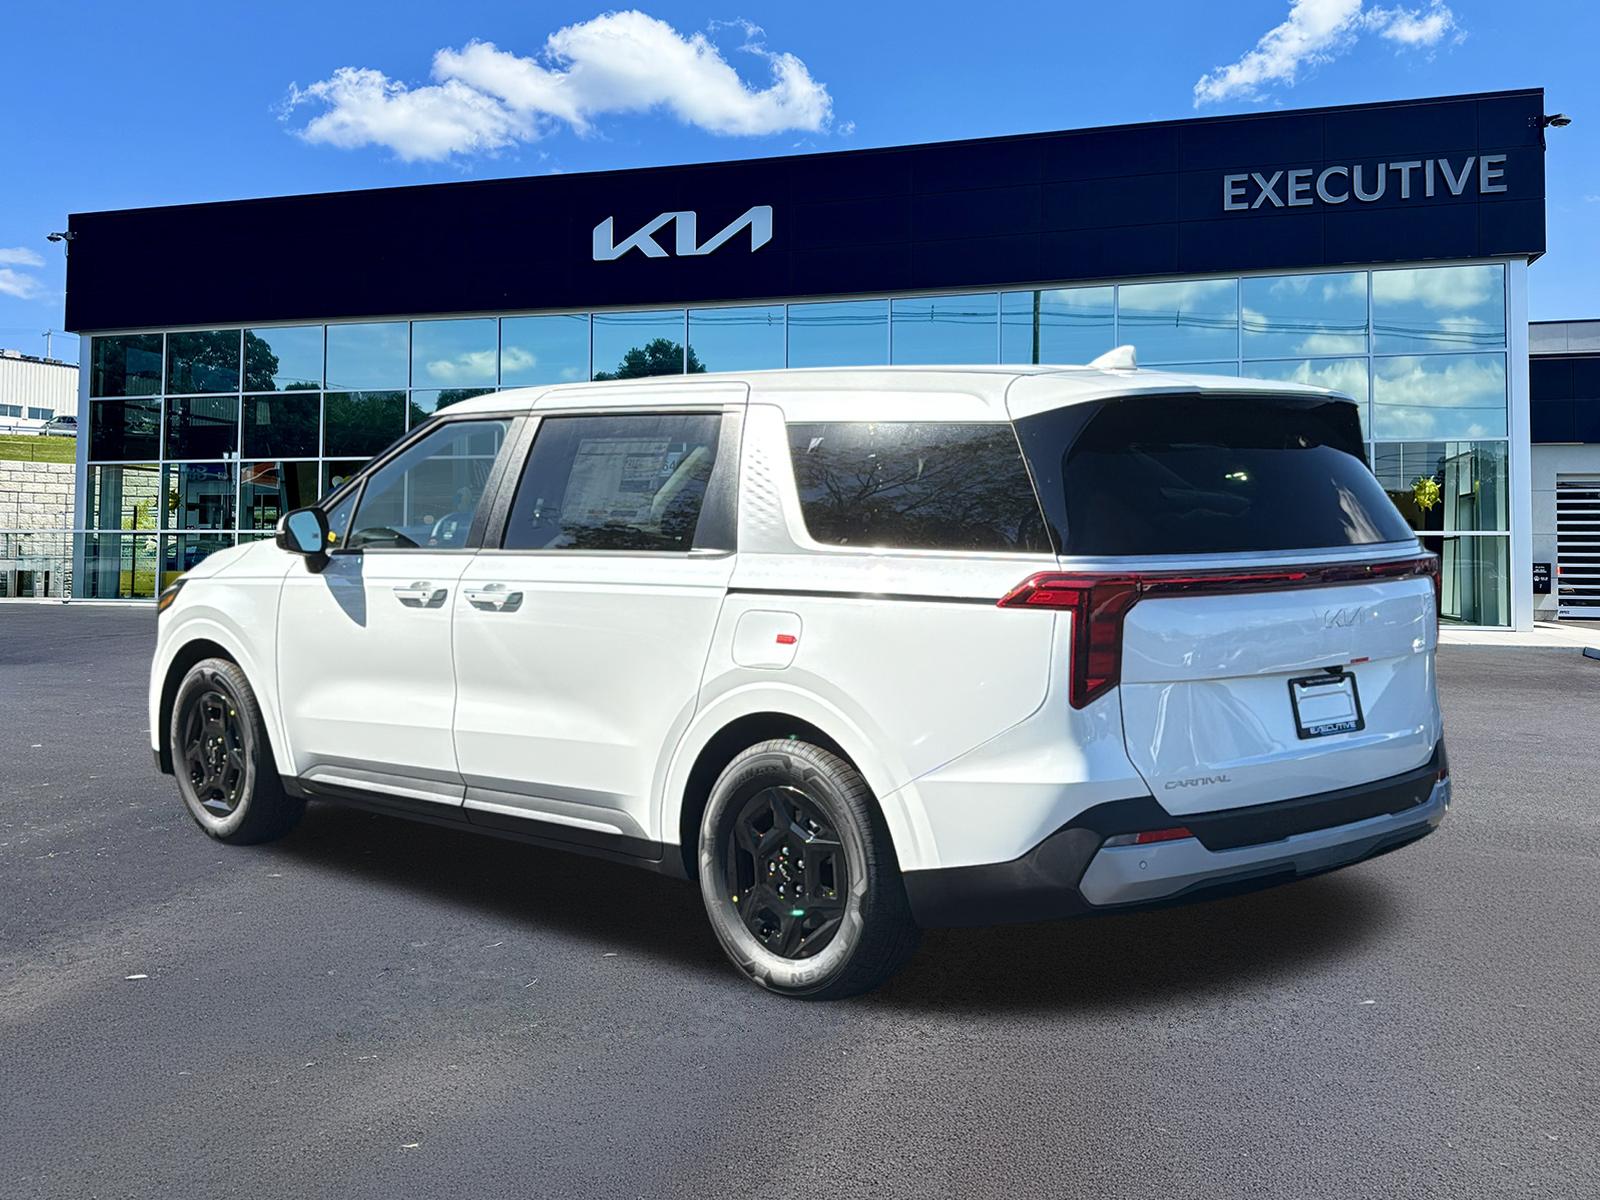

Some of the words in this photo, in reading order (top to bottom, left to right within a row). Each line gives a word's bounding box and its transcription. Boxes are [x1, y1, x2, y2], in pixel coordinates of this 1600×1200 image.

[1223, 154, 1508, 211] EXECUTIVE
[592, 205, 773, 261] KIA
[1164, 774, 1233, 791] CARNIVAL
